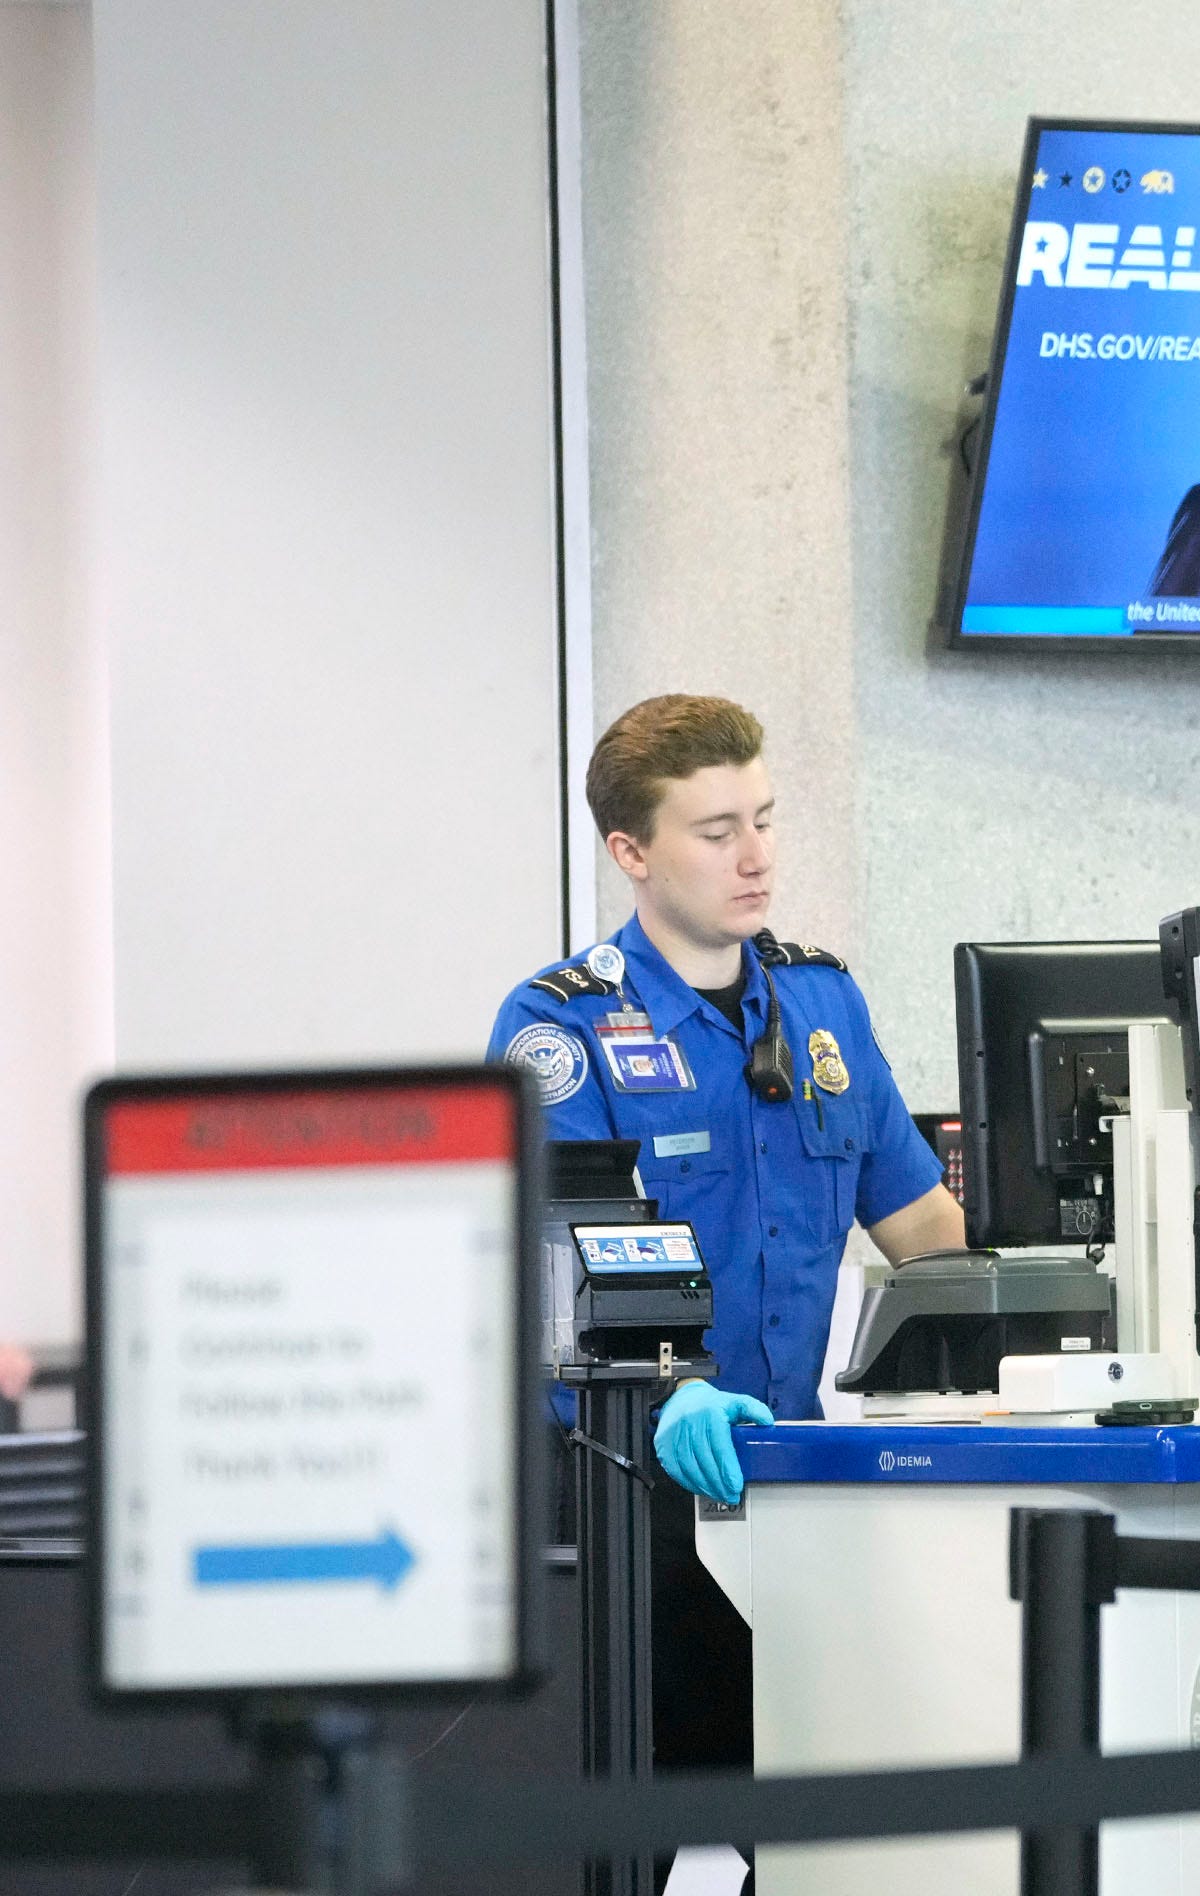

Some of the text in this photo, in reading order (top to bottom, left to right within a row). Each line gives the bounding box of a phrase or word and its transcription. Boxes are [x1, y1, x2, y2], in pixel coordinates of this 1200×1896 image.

[1127, 602, 1154, 622] the
[558, 968, 589, 988] TSA
[897, 1456, 933, 1467] IDEMIA
